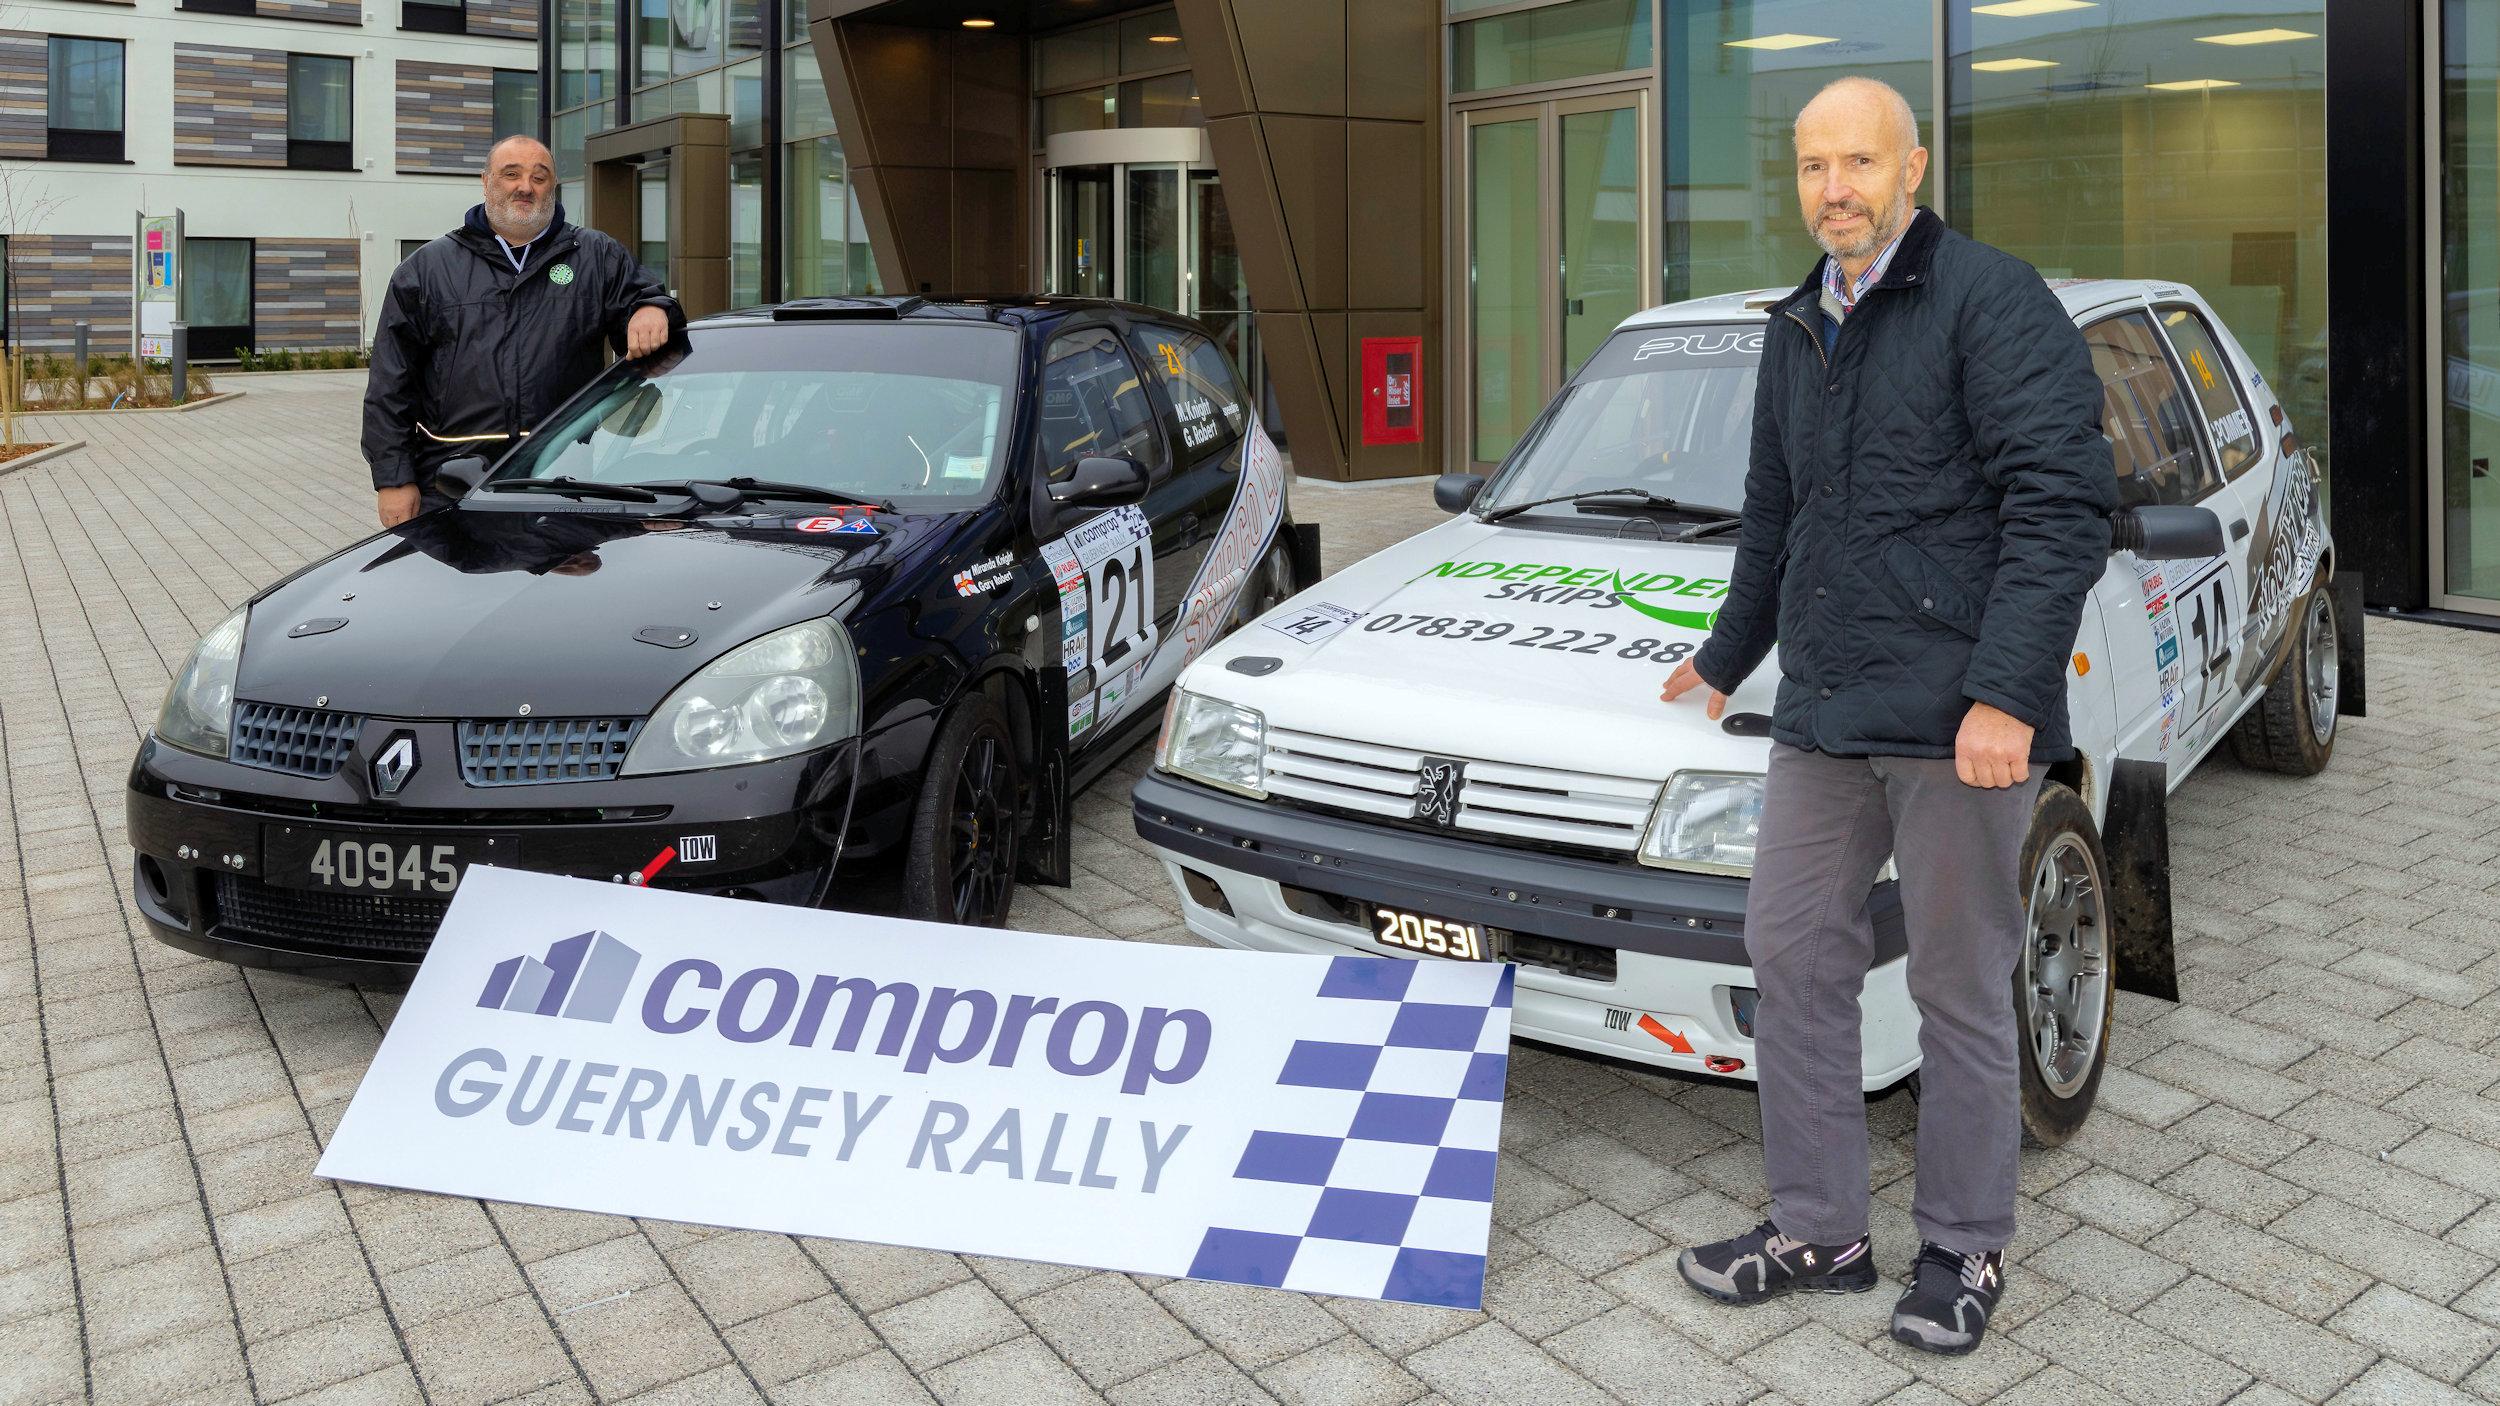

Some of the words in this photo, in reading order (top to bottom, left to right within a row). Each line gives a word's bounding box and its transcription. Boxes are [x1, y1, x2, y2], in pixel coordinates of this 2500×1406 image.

[1158, 343, 1185, 375] 21
[2190, 349, 2216, 390] 14
[1192, 419, 1218, 446] Robert
[1082, 517, 1120, 543] comprop
[971, 558, 997, 576] Miranda
[995, 551, 1014, 566] Knight
[1405, 561, 1730, 600] NDEPENDE
[977, 578, 996, 592] Gary
[992, 571, 1013, 586] Robert
[1484, 583, 1637, 609] SKIPS
[1101, 545, 1149, 668] 21
[1283, 615, 1332, 635] 14
[1363, 613, 1515, 642] 07839
[1509, 626, 1618, 655] 222
[1616, 638, 1695, 664] 88
[2191, 578, 2232, 714] 14
[310, 838, 459, 892] 40945
[680, 836, 716, 862] TOW
[1376, 909, 1481, 961] 20531
[641, 954, 1214, 1095] comprop
[1604, 1008, 1632, 1032] TOW
[433, 1046, 892, 1158] GUERNSEY
[907, 1101, 1192, 1195] RALLY
